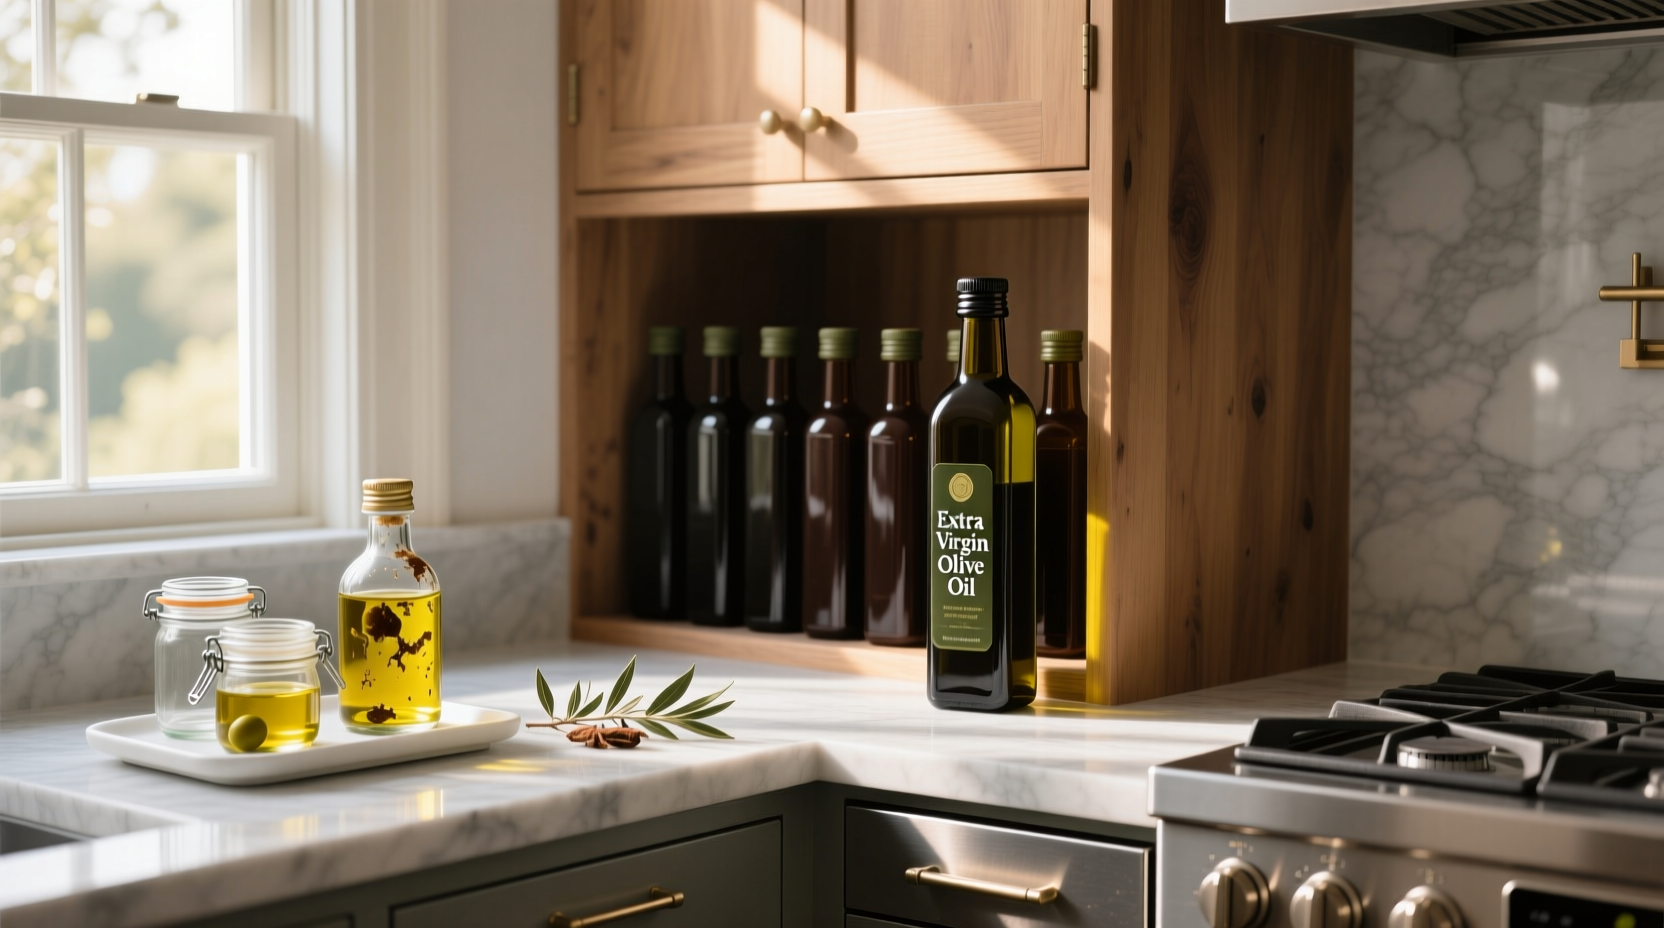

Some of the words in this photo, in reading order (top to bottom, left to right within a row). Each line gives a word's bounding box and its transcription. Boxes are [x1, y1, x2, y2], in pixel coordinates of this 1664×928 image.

[937, 510, 984, 530] Extra
[936, 531, 989, 555] Virgin
[937, 554, 984, 574] Olive
[947, 576, 976, 596] Oil
